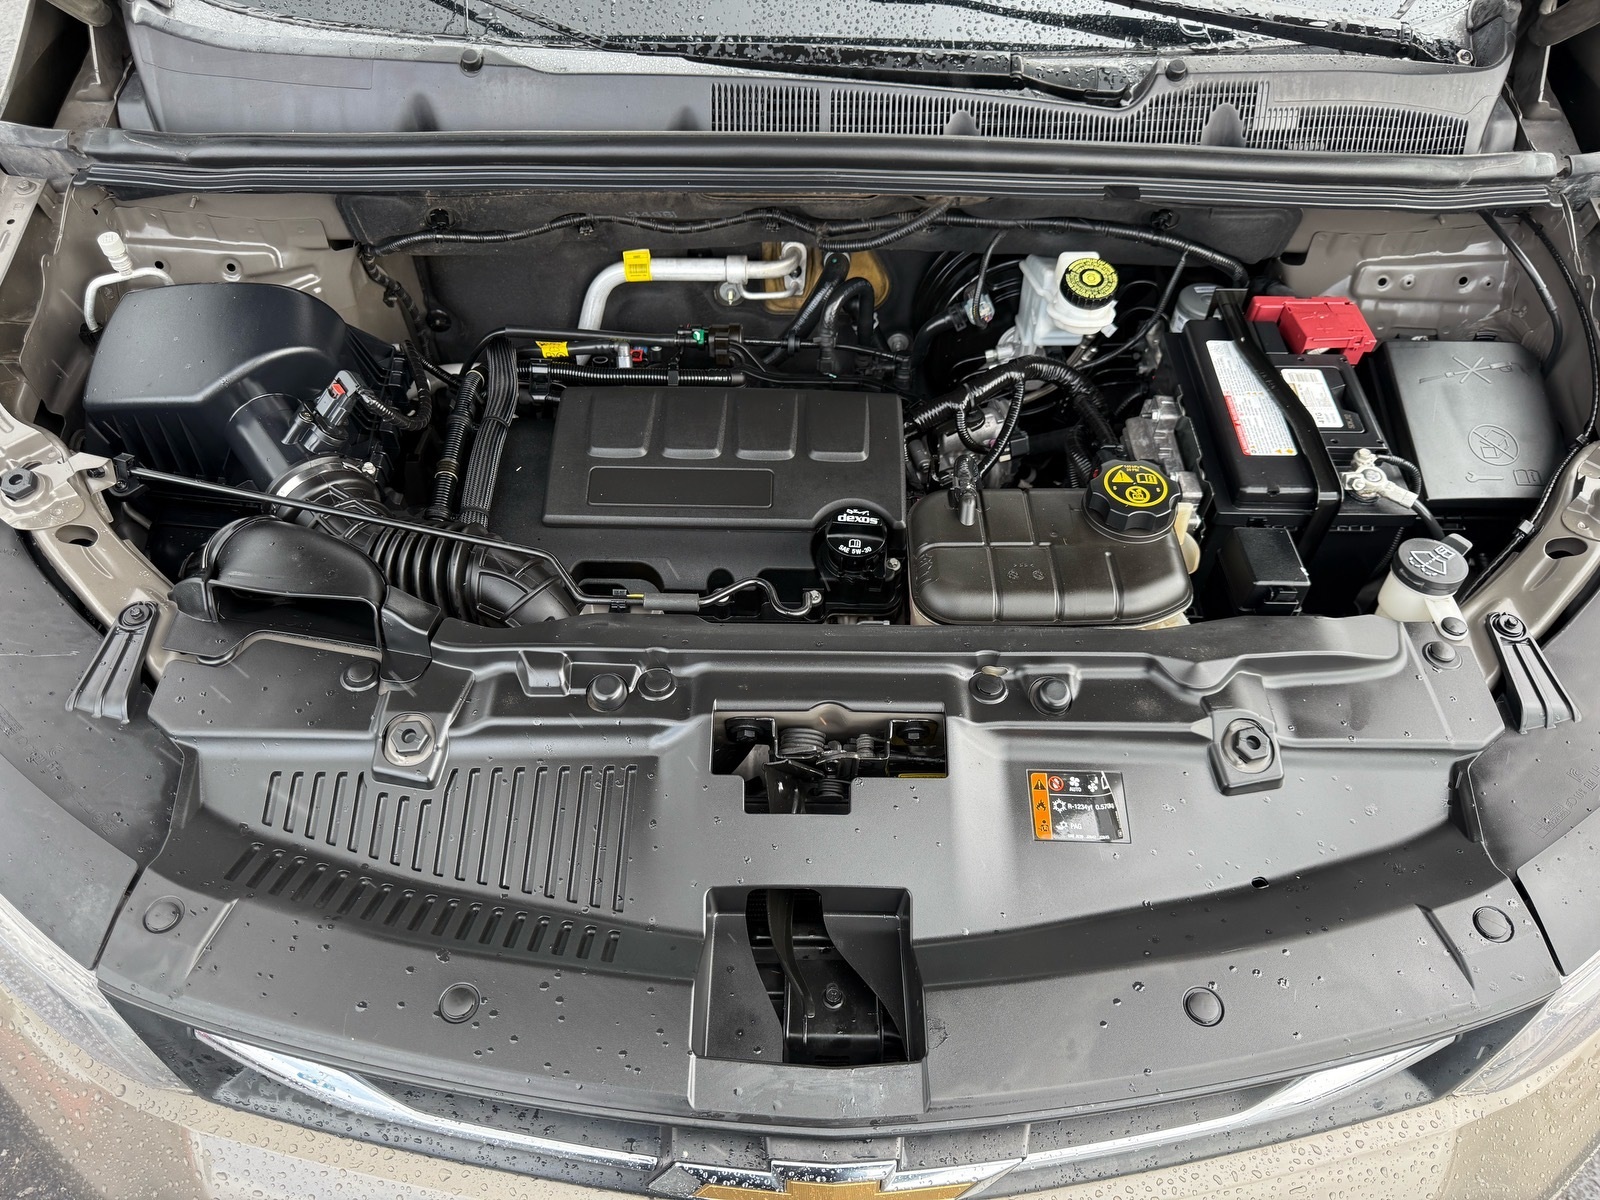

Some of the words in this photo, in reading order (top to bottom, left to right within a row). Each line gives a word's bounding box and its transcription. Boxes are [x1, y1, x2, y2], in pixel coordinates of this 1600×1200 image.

[837, 513, 879, 524] dexos
[838, 544, 850, 553] SAE
[851, 546, 872, 554] 5W-30
[1070, 822, 1082, 830] PAG
